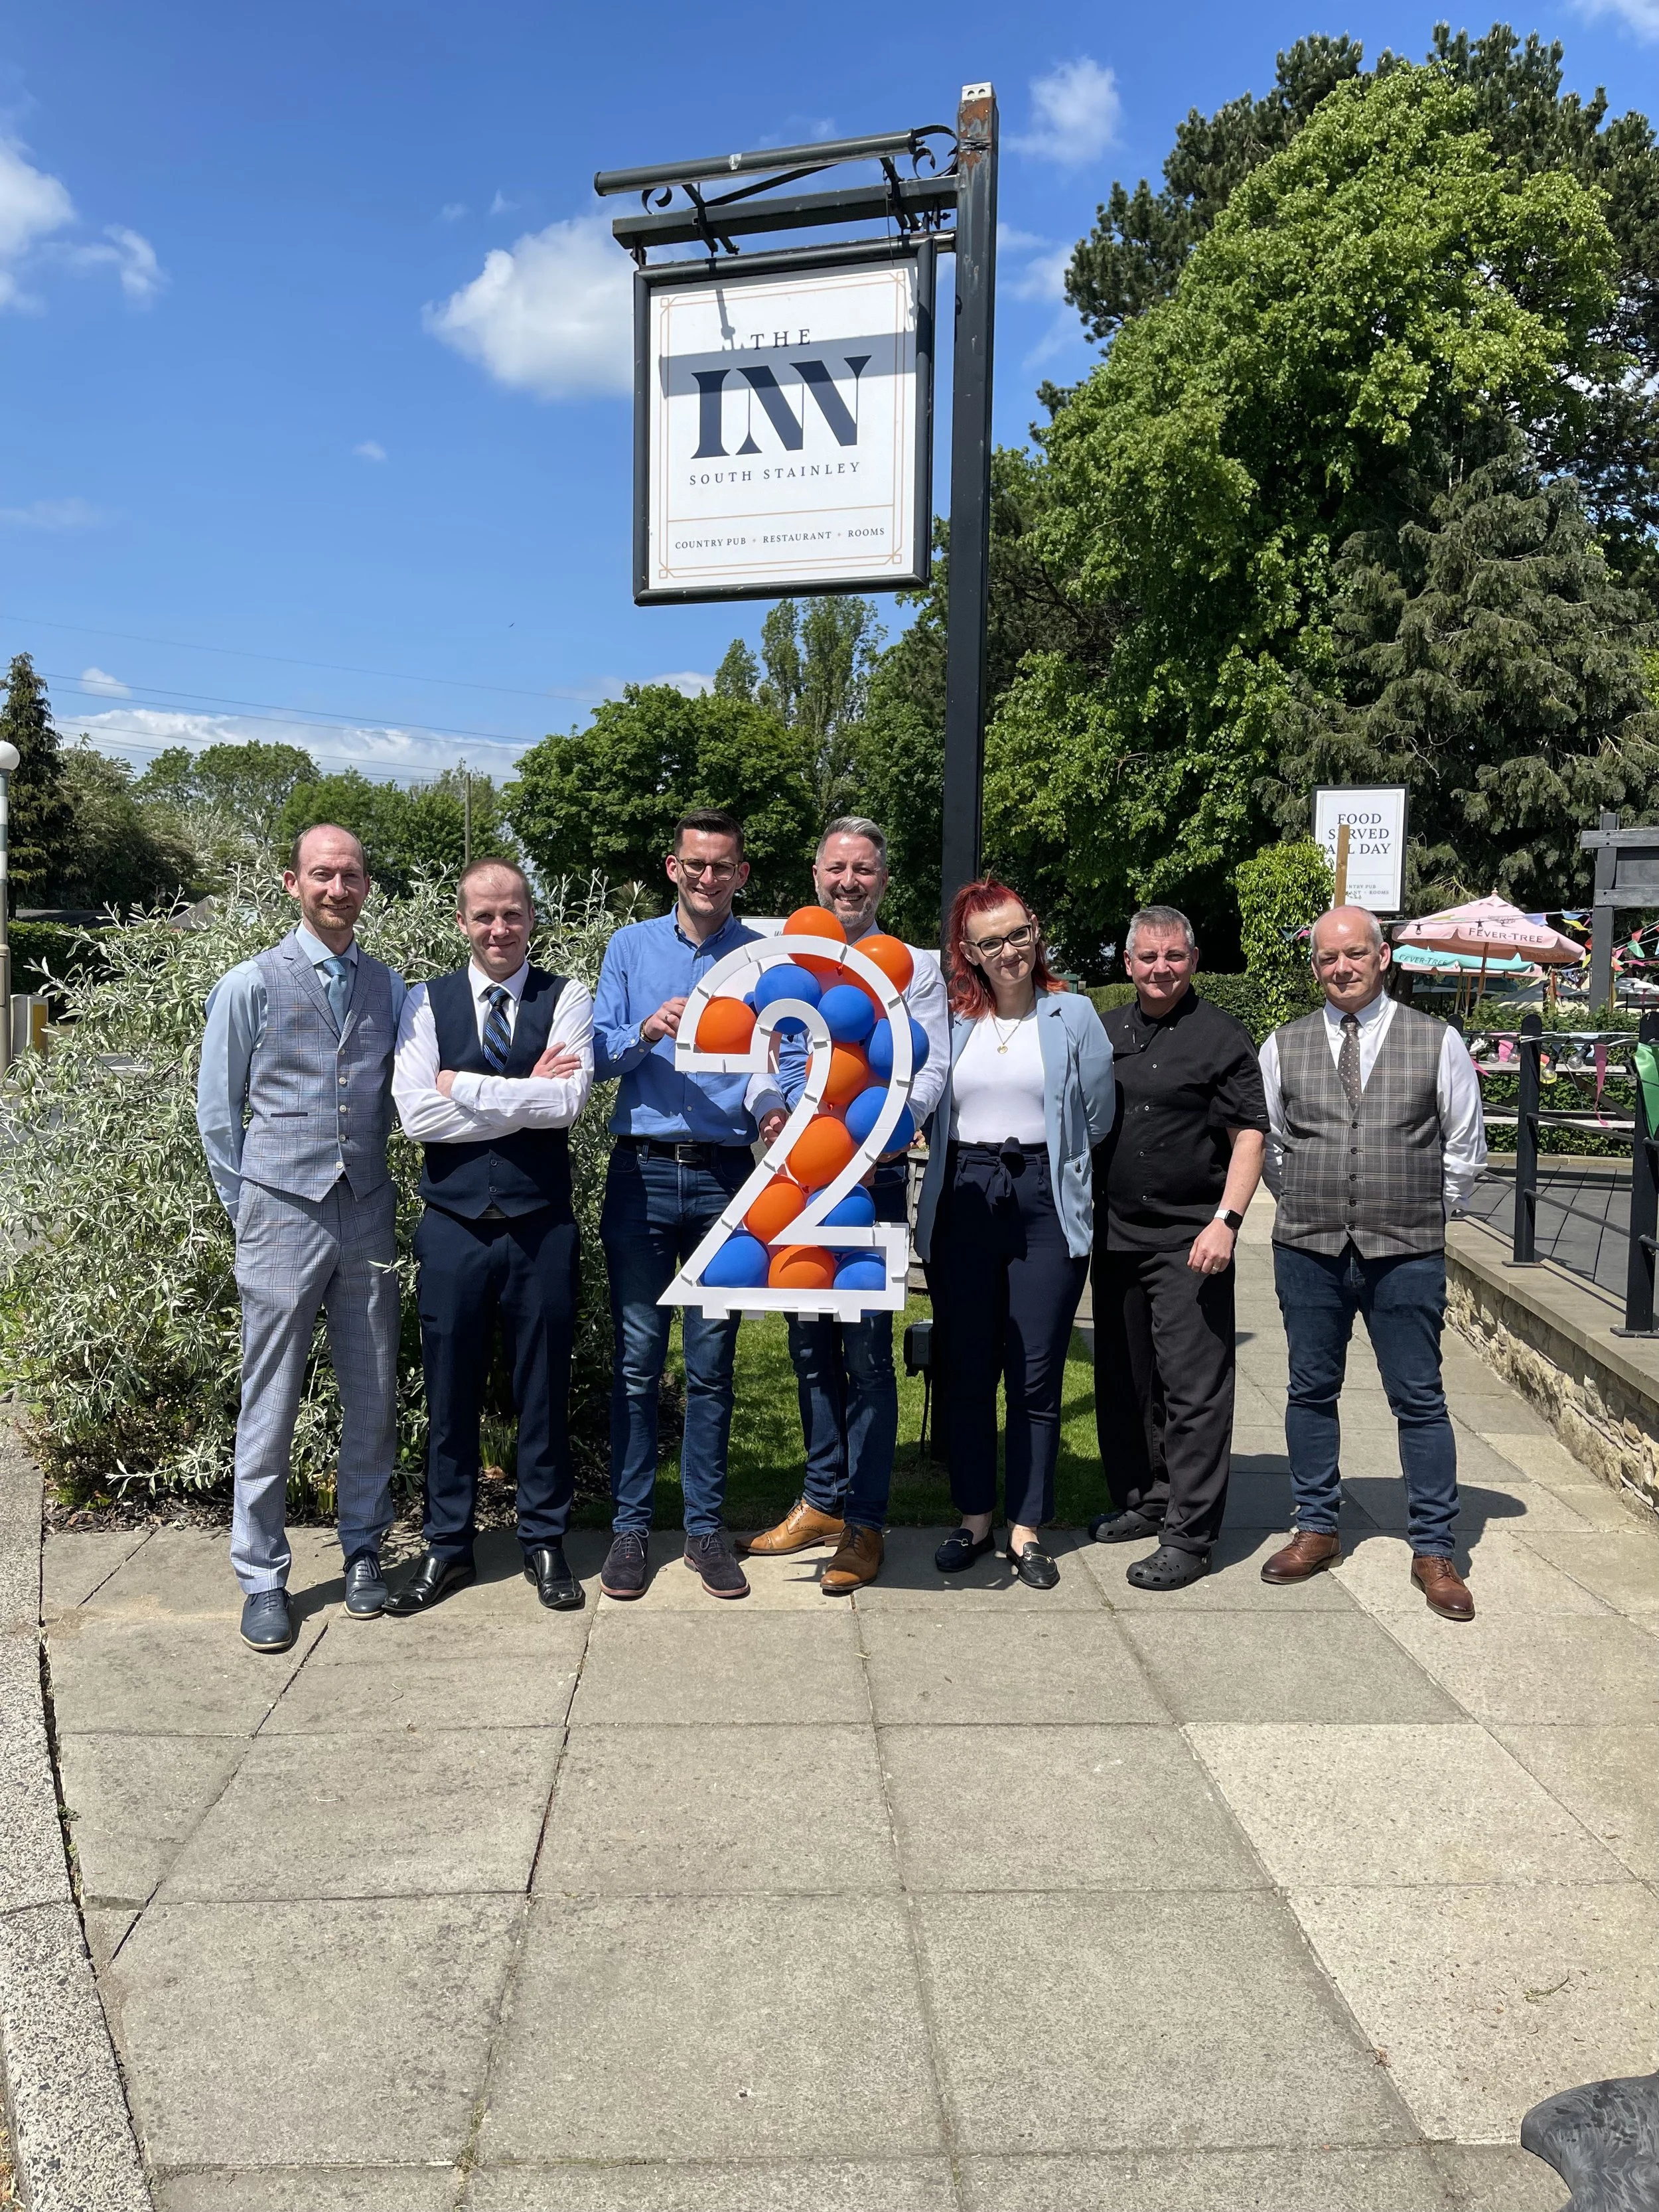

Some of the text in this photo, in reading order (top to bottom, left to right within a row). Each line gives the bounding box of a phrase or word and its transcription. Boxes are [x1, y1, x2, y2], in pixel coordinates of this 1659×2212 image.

[750, 329, 811, 350] THE
[689, 462, 860, 485] SOUTH STAINLEY
[675, 527, 885, 550] COUNTRY PUB RESTAURANT ROOMS
[1337, 813, 1382, 825] FOOD
[1328, 828, 1390, 840] SRVED
[1327, 843, 1392, 855] AL DAY
[1469, 928, 1544, 943] FEVER-TREE
